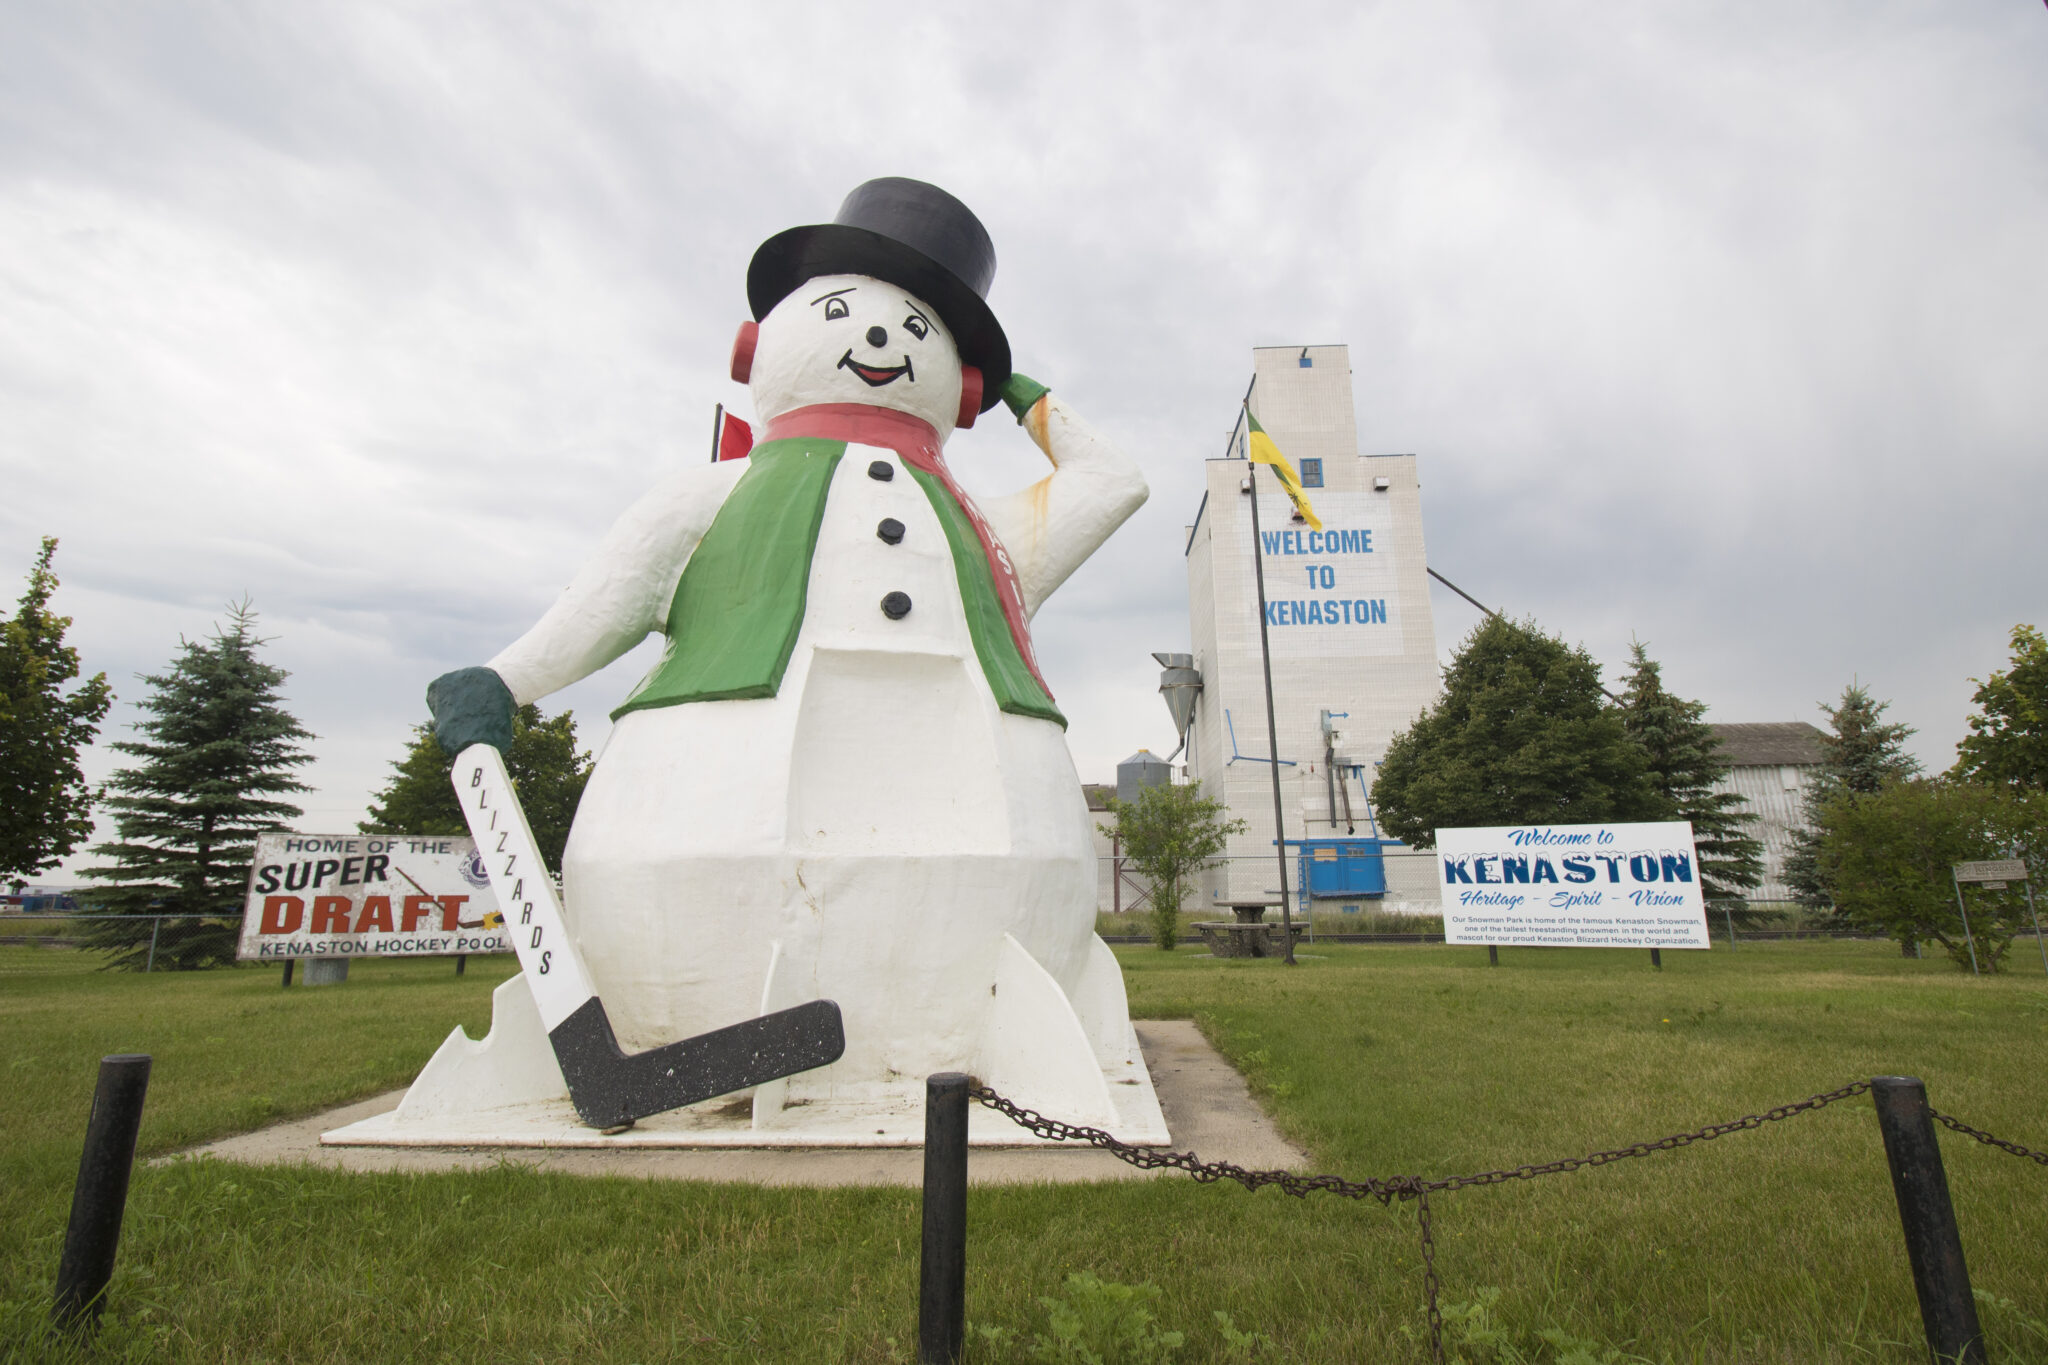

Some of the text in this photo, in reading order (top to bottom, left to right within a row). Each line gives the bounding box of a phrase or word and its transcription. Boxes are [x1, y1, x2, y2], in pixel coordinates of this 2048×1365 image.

[1261, 530, 1373, 556] WELCOME
[1305, 564, 1336, 590] TO
[1264, 599, 1387, 626] KENASTON
[286, 839, 452, 854] HOME OF THE
[1507, 828, 1615, 846] Welcome to
[255, 854, 390, 894] SUPER
[471, 767, 552, 976] BLIZZARDS
[1443, 849, 1694, 884] KENASTON
[1459, 890, 1525, 910] Heritage
[1549, 891, 1602, 910] Spirit
[1629, 889, 1684, 907] Vision
[259, 895, 470, 935] DRAFT
[1534, 916, 1556, 924] home
[1558, 916, 1566, 924] of
[1583, 917, 1613, 925] famous
[1615, 917, 1655, 925] Kenaston
[1657, 917, 1702, 926] Snowman,
[1512, 935, 1536, 943] proud
[1537, 935, 1575, 943] Kenaston
[1576, 935, 1609, 944] Blizzard
[1611, 936, 1642, 946] Hockey
[1644, 936, 1702, 946] Organization.
[1528, 926, 1578, 935] freestanding
[1631, 927, 1645, 935] the
[1647, 927, 1671, 935] world
[1673, 927, 1690, 935] and
[259, 937, 506, 957] KENASTON HOCKEY POOL
